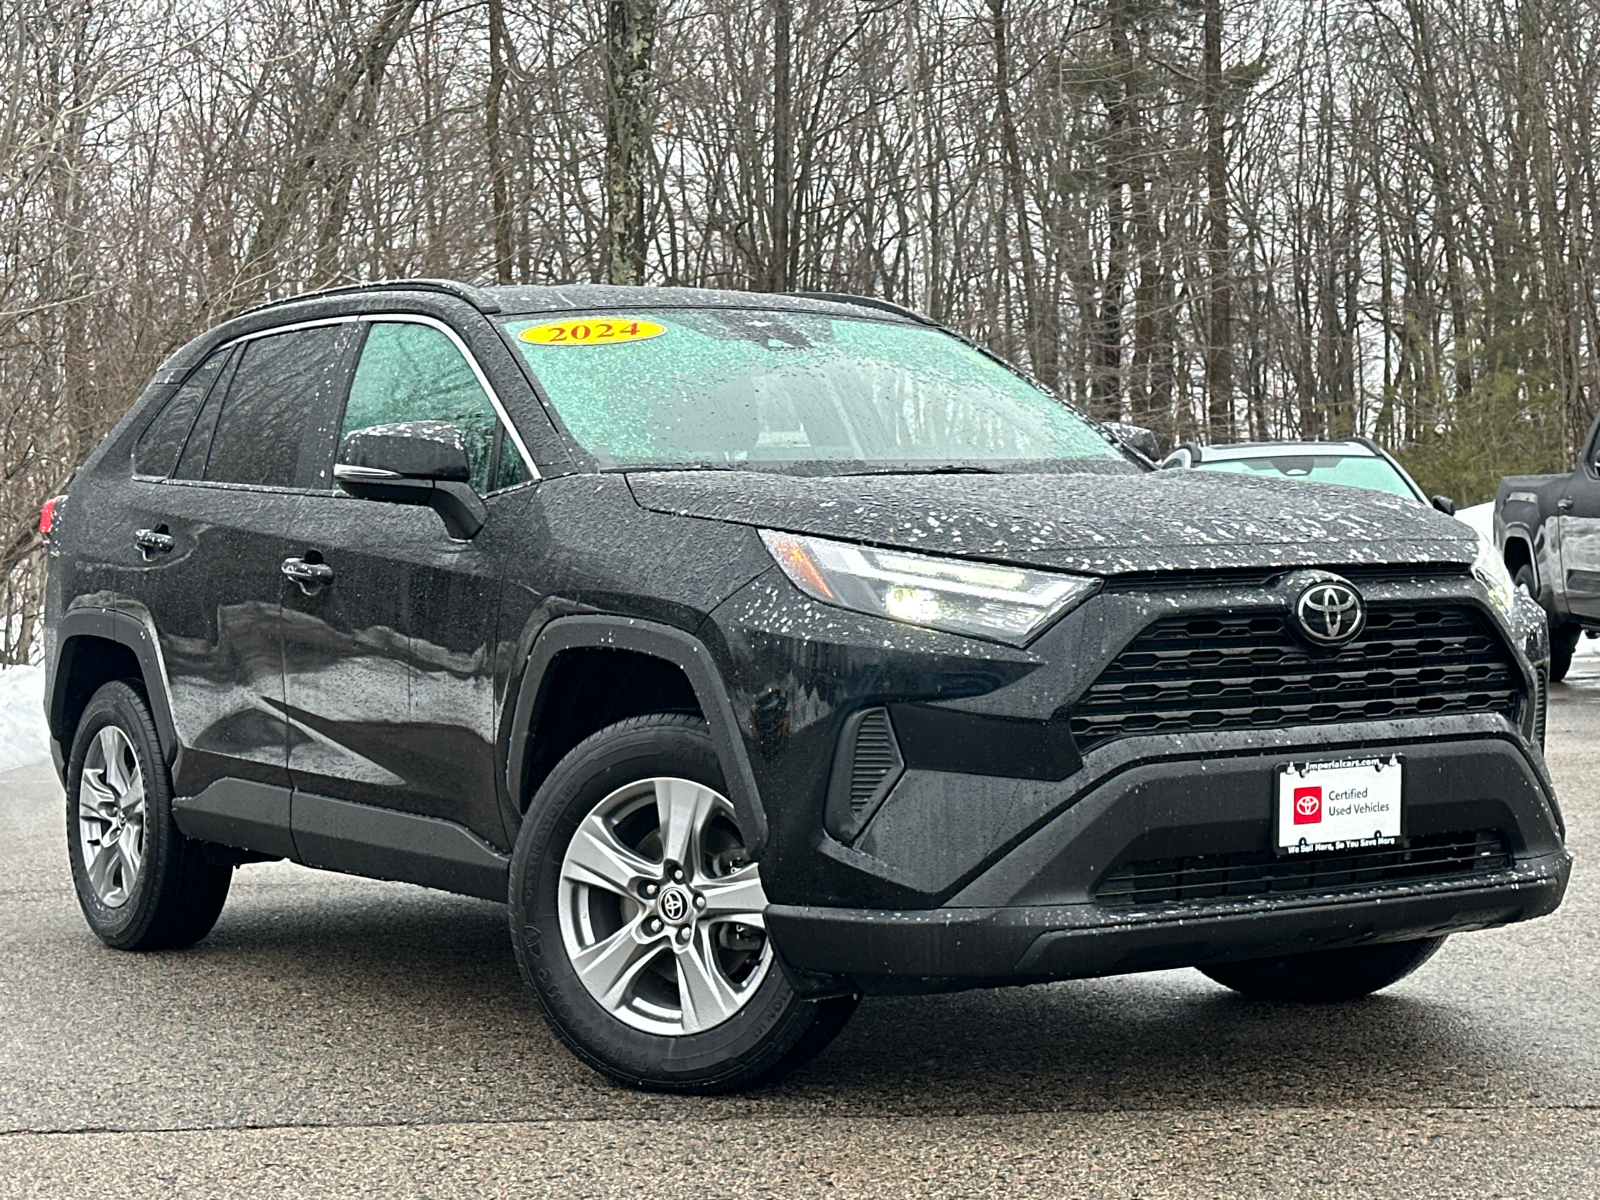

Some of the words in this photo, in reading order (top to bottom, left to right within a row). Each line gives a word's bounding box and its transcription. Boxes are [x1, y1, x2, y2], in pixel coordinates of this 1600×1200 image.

[547, 322, 640, 343] 2024
[1305, 759, 1380, 771] Imperialcars.com
[1328, 787, 1368, 801] Certified
[1328, 804, 1352, 816] Used
[1353, 801, 1390, 814] Vehicles
[1287, 846, 1299, 854] We
[1300, 844, 1314, 853] Sell
[1335, 841, 1344, 850] So
[1346, 841, 1360, 849] You
[1360, 839, 1377, 847] Save
[1378, 837, 1396, 845] More
